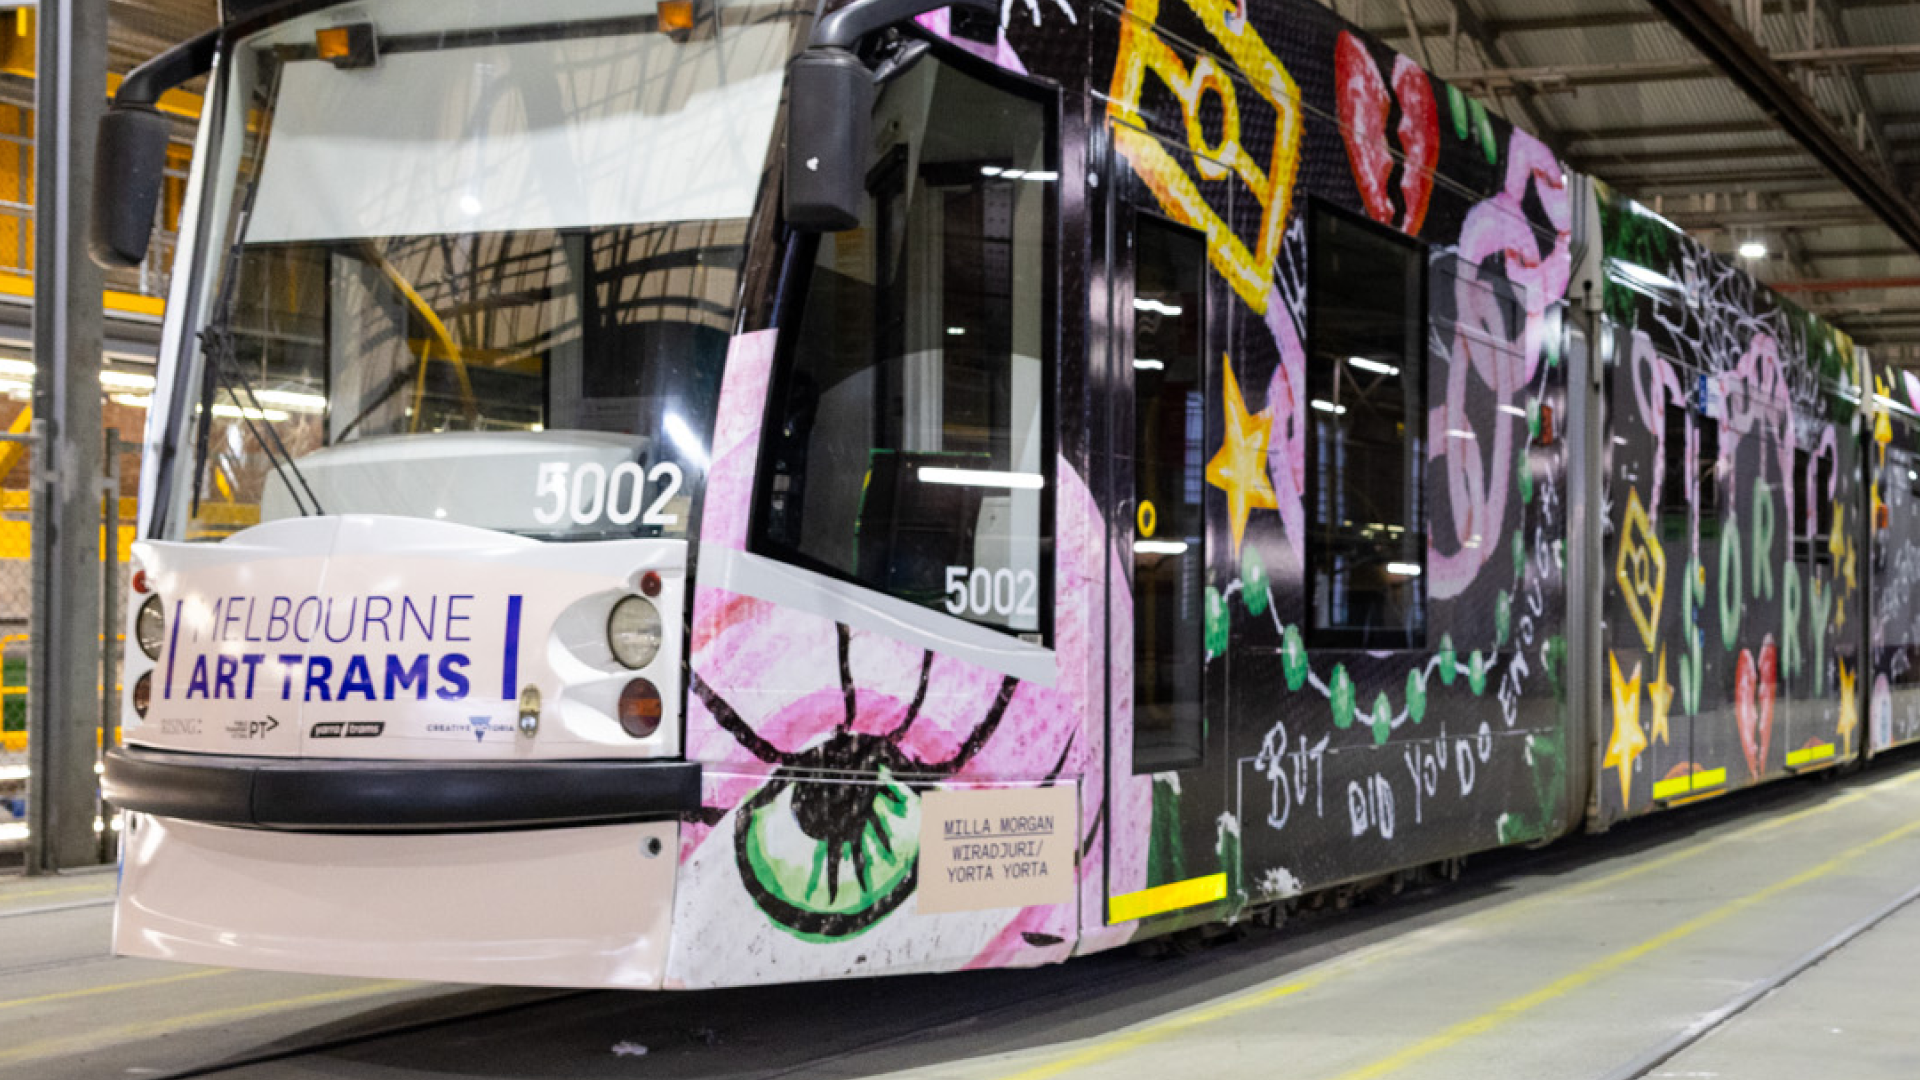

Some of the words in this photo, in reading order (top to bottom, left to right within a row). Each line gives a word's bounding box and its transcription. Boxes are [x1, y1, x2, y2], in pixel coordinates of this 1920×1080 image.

[533, 461, 683, 525] 5002
[945, 566, 1037, 615] 5002
[1679, 476, 1831, 716] SORRY
[186, 654, 266, 699] ART
[278, 652, 471, 702] TRAMS
[1254, 721, 1330, 829] BUT
[1348, 773, 1395, 839] DID
[1404, 721, 1447, 824] YOU
[1455, 721, 1492, 796] DO
[944, 818, 991, 836] MILLA
[1000, 815, 1054, 833] MORGAN
[947, 865, 993, 883] YORTA
[1003, 861, 1048, 879] YORTA
